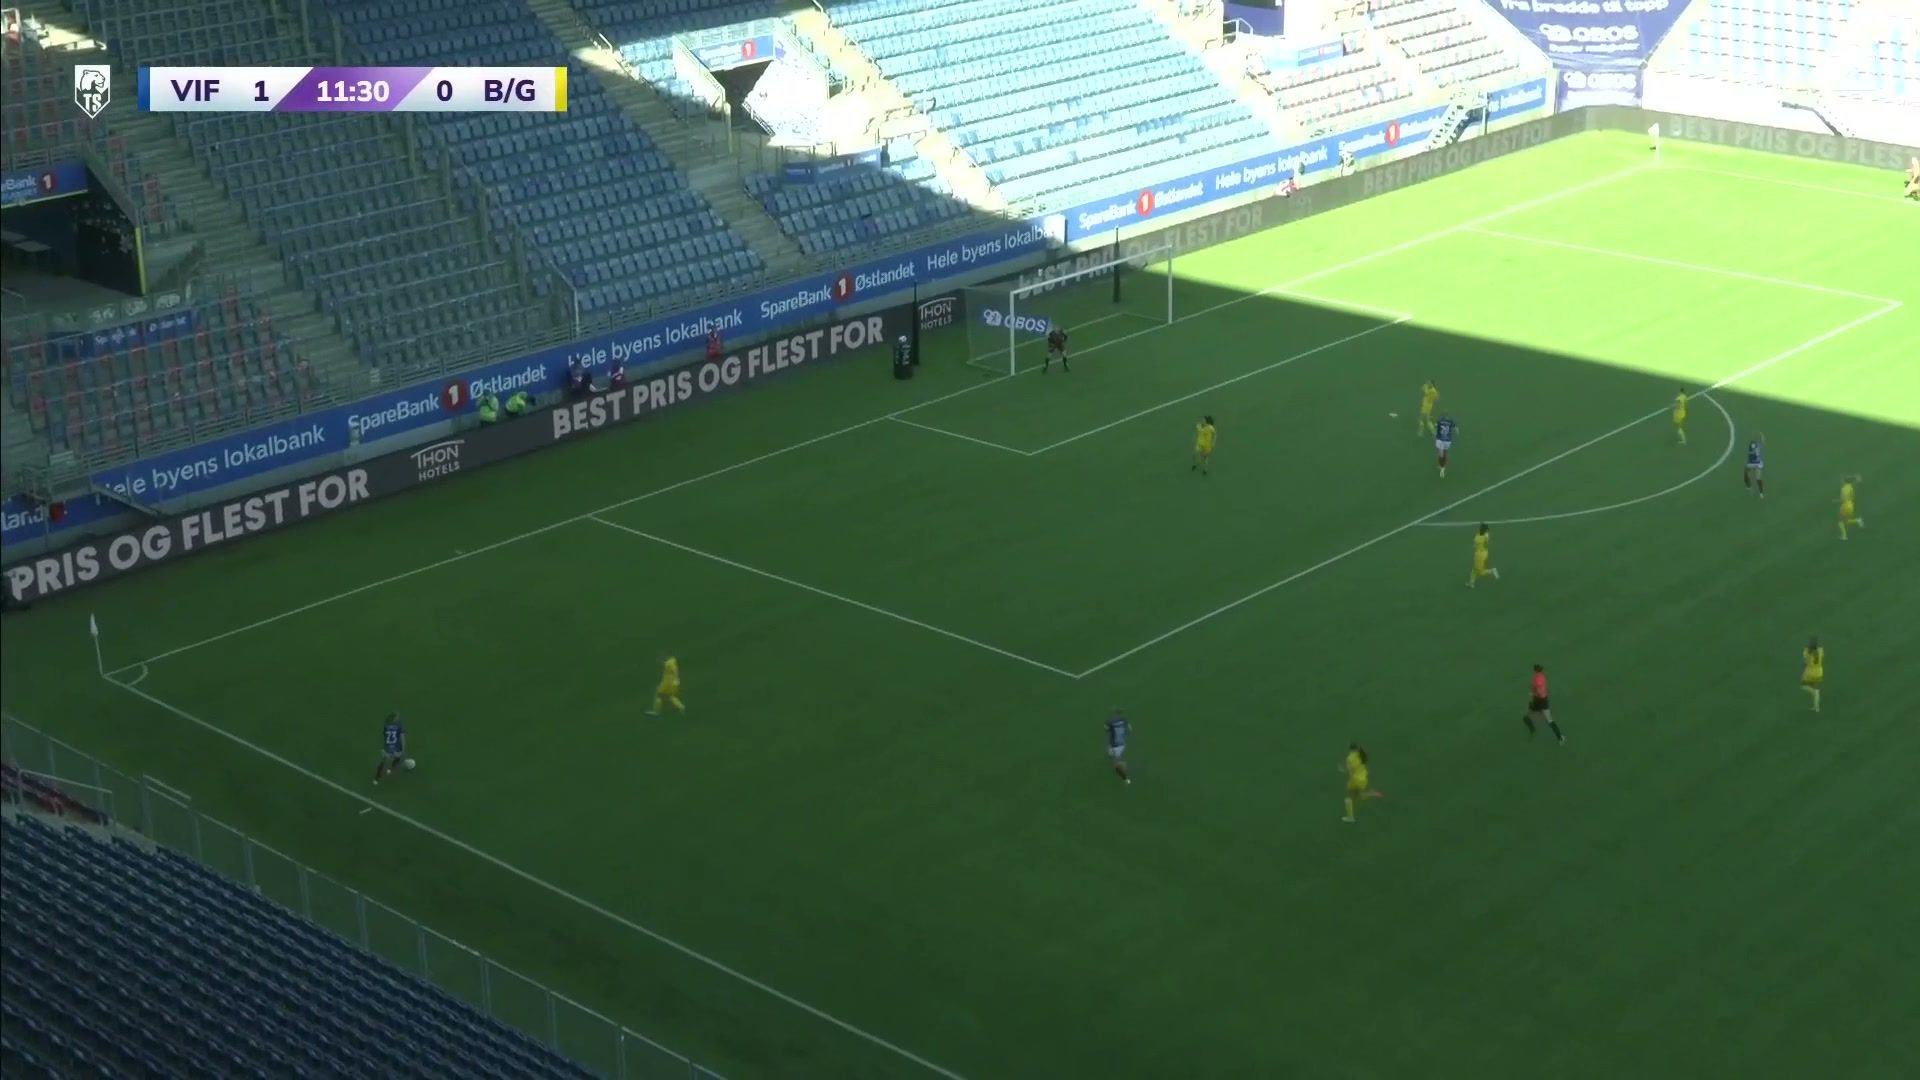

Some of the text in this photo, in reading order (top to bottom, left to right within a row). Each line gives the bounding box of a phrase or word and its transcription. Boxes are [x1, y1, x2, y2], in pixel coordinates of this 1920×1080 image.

[1669, 116, 1728, 141] BEST
[1735, 124, 1786, 153] PRIS
[1798, 134, 1839, 158] OG
[43, 173, 51, 189] 1
[1364, 161, 1404, 194] BEST
[1447, 143, 1472, 169] OG
[1142, 193, 1149, 212] 1
[1225, 205, 1262, 236] FOR
[927, 250, 958, 271] Hele
[962, 240, 1001, 262] byens
[761, 262, 915, 319] SpareBank 1 Østlandet
[919, 297, 956, 320] THON
[920, 315, 952, 330] HOTELS
[1004, 314, 1047, 333] OBOS
[611, 333, 661, 360] byens
[666, 308, 742, 344] lokalbank
[553, 389, 626, 439] BEST
[633, 371, 692, 415] PRIS
[698, 356, 740, 392] OG
[748, 329, 823, 378] FLEST
[830, 317, 883, 354] FOR
[348, 365, 547, 435] SpareBank 1 Østlandet
[152, 458, 218, 491] byens
[224, 424, 325, 468] lokalbank
[411, 440, 464, 469] THON
[419, 462, 461, 481] HOTELS
[10, 468, 369, 600] PRIS OG FLEST FOR
[385, 731, 397, 744] 23
